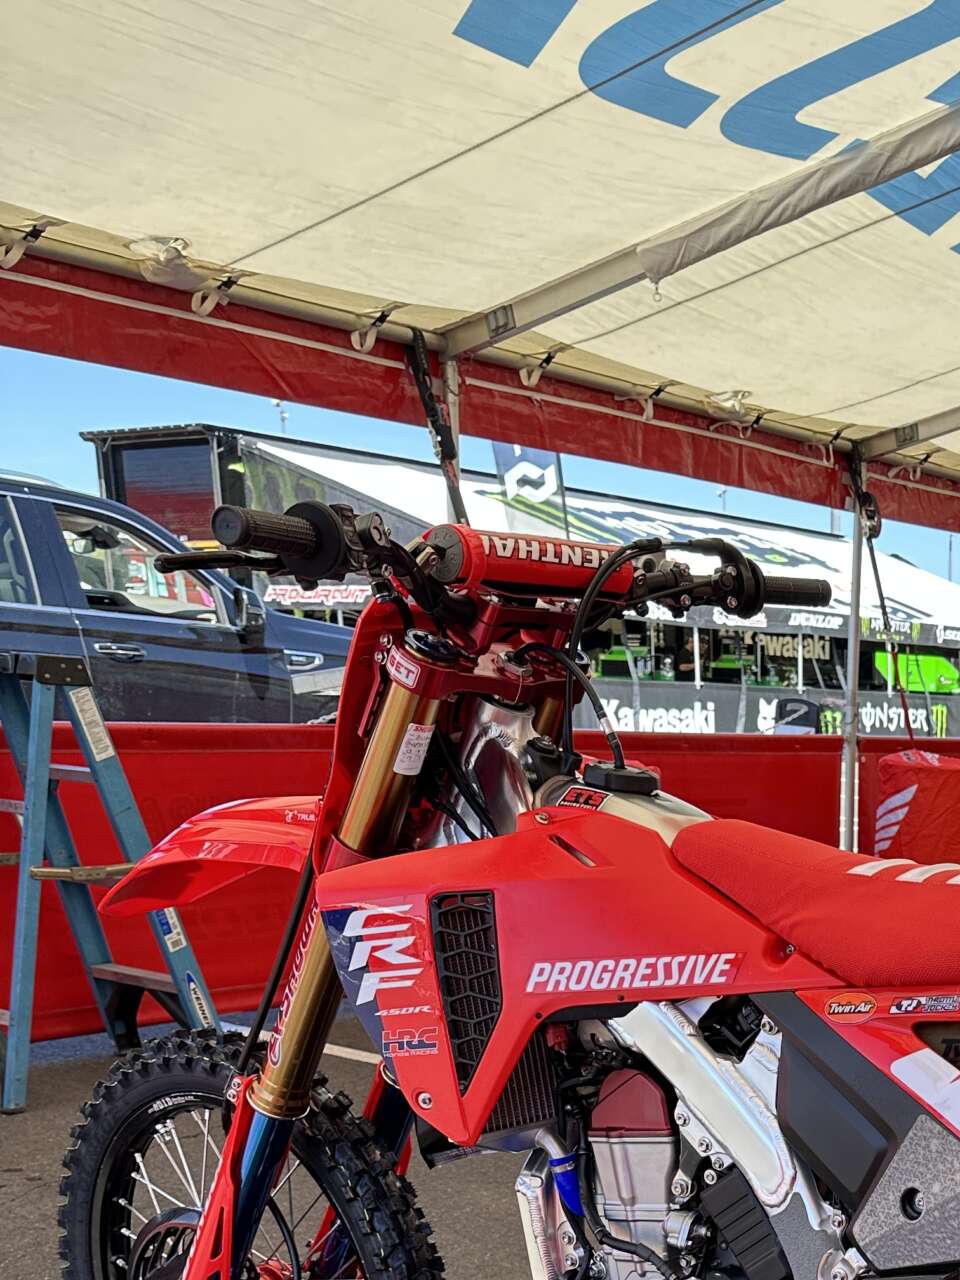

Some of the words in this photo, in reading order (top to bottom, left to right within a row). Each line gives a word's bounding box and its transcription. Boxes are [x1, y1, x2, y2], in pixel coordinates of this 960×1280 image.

[389, 655, 415, 679] GET
[600, 698, 716, 734] Kawasaki
[564, 787, 604, 803] ETS
[343, 904, 424, 1006] CRF
[525, 951, 737, 994] PROGRESSIVE
[375, 1004, 432, 1017] 450R
[828, 1003, 855, 1014] Twin
[856, 1002, 873, 1013] Air
[382, 1026, 438, 1050] HRC
